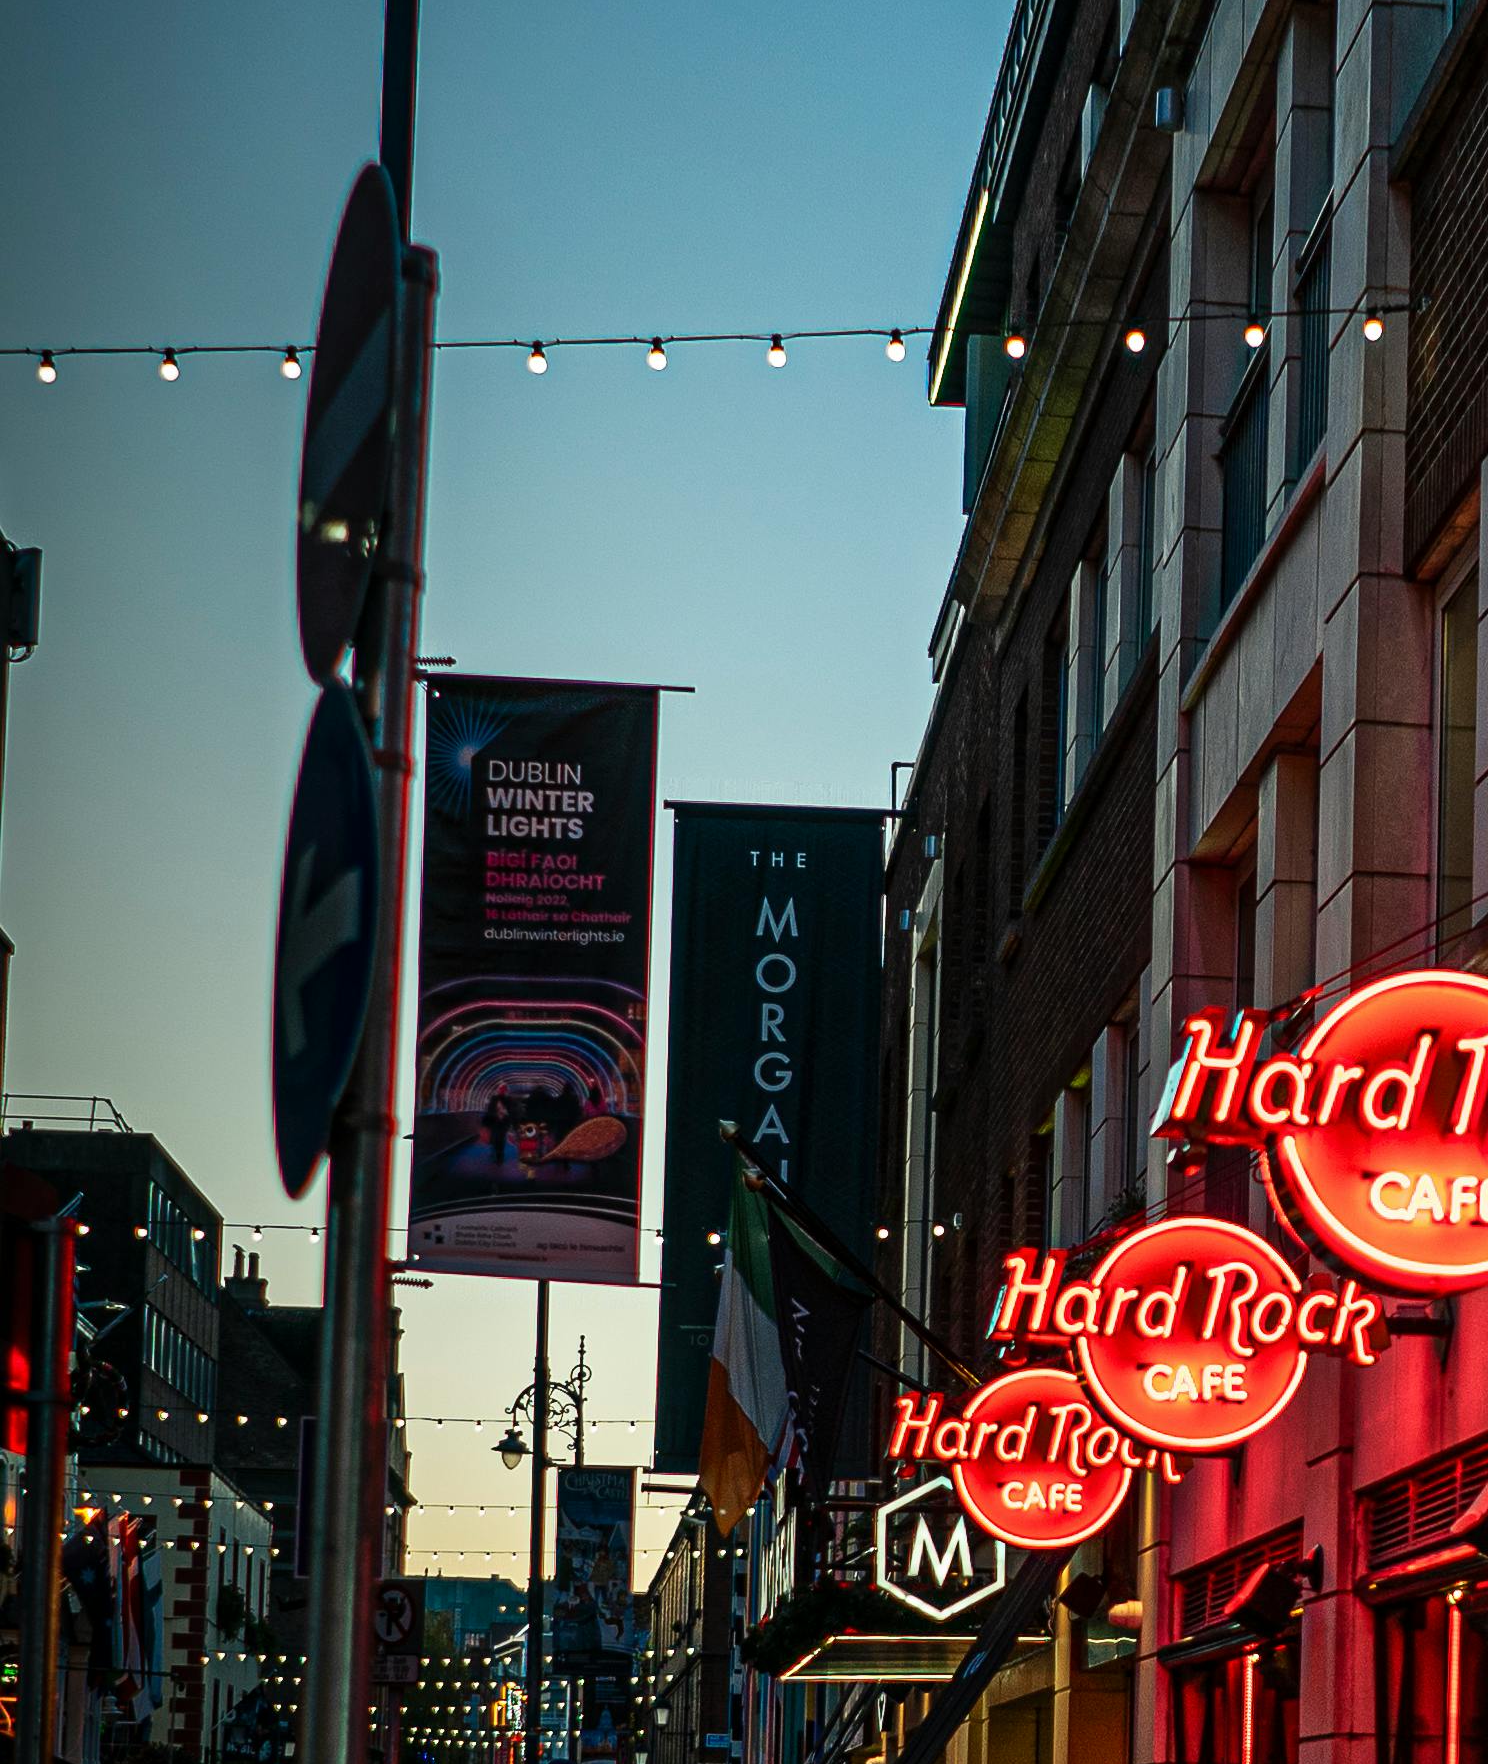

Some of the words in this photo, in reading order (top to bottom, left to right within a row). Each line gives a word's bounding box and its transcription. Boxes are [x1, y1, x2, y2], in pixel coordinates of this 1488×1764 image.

[488, 759, 581, 785] DUBLIN
[486, 787, 595, 814] WINTER
[486, 814, 585, 840] LIGHTS
[530, 853, 578, 870] FAOI
[749, 850, 807, 868] THE
[485, 870, 606, 891] DHRAÍOCHT
[484, 927, 626, 946] dublinwinterlights.ie
[1168, 1013, 1434, 1133] Hard
[994, 1253, 1189, 1339] Hard
[1201, 1260, 1377, 1365] Rock
[1141, 1362, 1249, 1402] CAFE
[887, 1394, 1038, 1462] Hard
[1001, 1480, 1084, 1512] CAFE
[906, 1512, 975, 1587] M
